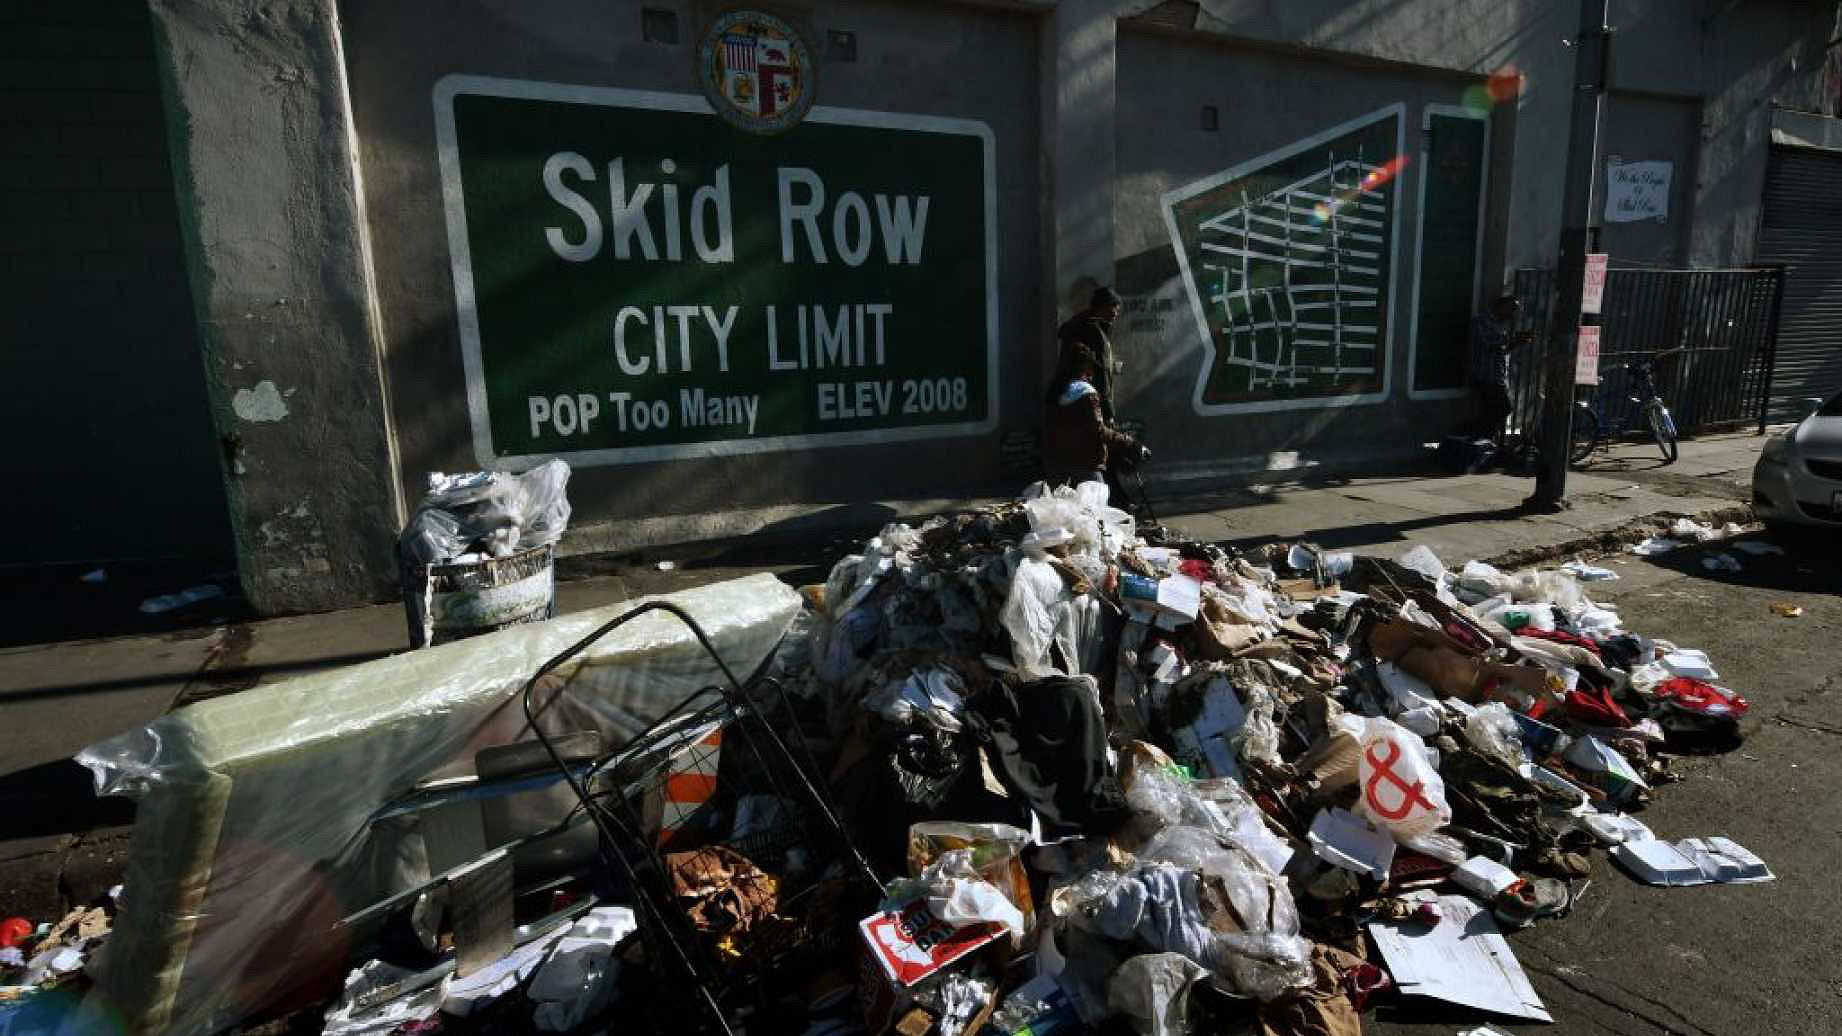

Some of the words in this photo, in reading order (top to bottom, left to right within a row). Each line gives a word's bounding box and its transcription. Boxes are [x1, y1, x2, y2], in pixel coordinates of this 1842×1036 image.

[542, 151, 735, 265] Skid
[777, 167, 931, 267] Row
[614, 303, 738, 376] CITY
[765, 303, 893, 371] LIMIT
[527, 393, 600, 438] POP
[609, 391, 670, 432] Too
[680, 388, 761, 435] Many
[817, 379, 894, 420] ELEV
[902, 377, 968, 414] 2008
